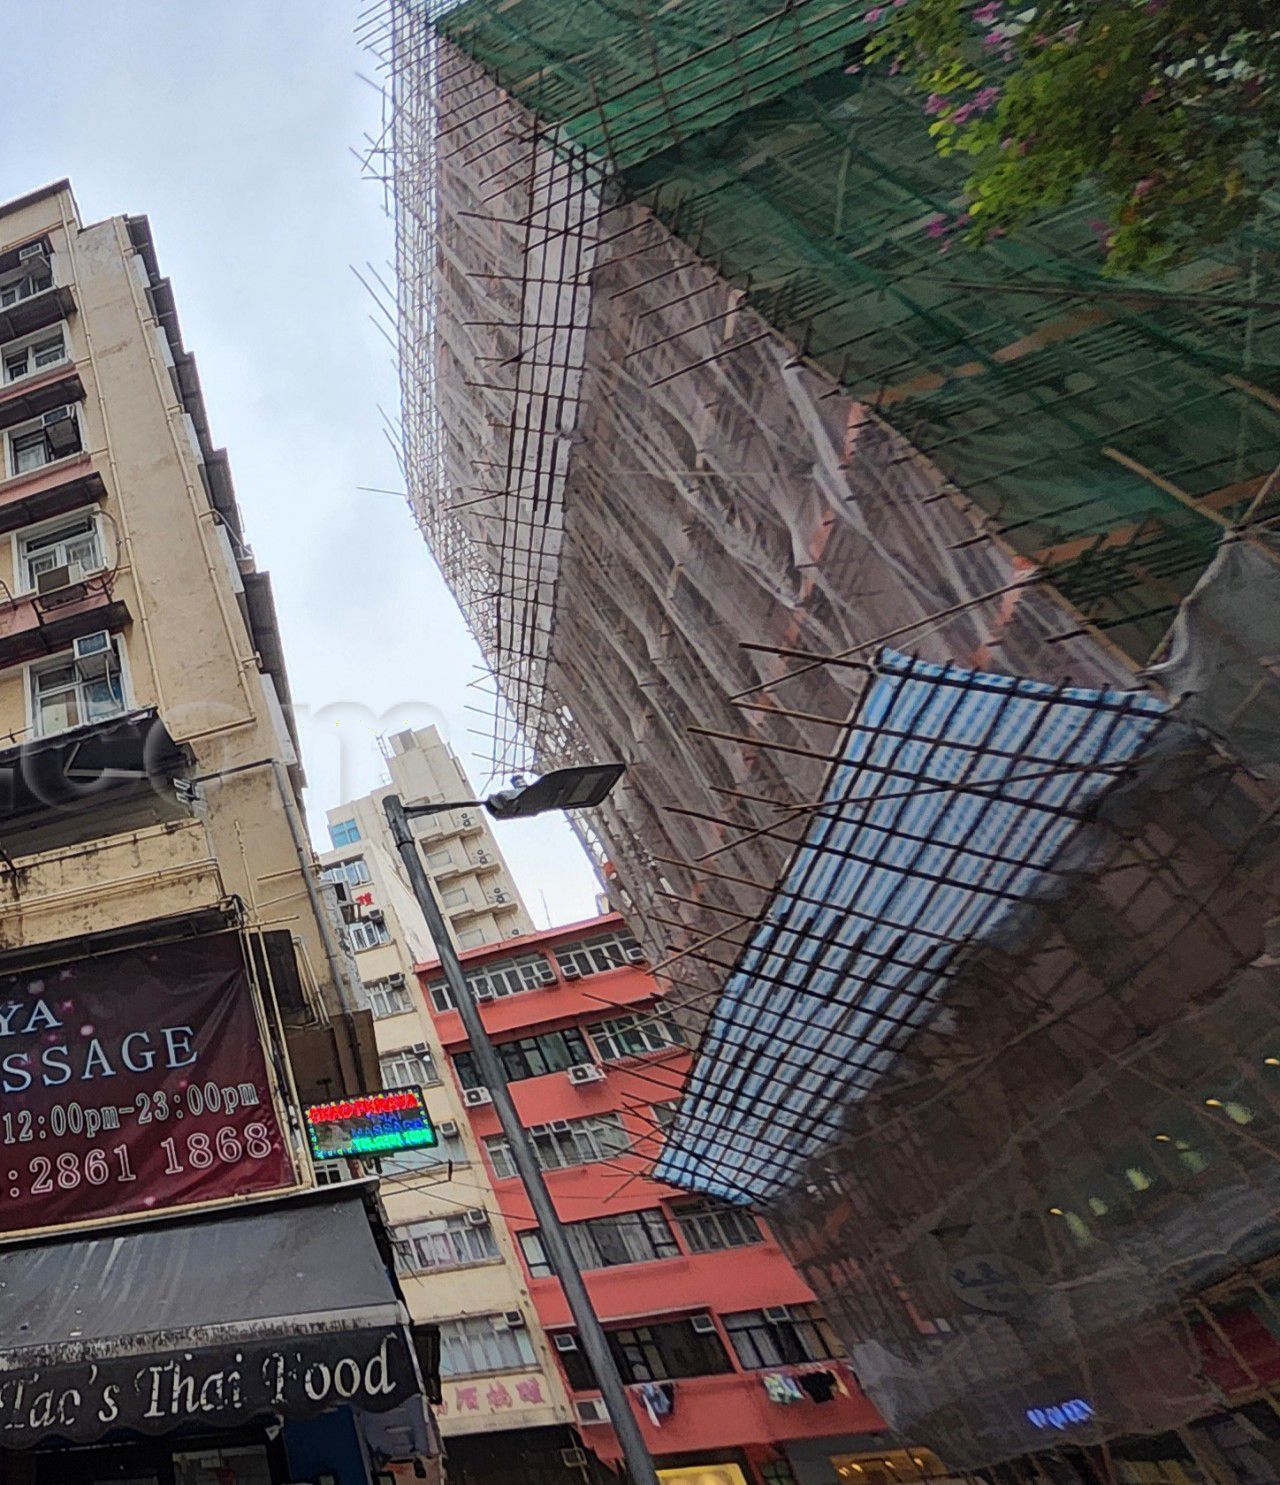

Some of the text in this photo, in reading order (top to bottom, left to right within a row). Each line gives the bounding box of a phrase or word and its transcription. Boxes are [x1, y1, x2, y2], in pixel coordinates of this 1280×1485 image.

[161, 1122, 272, 1174] 1868
[134, 1353, 248, 1418] Thai
[261, 1332, 398, 1404] Food
